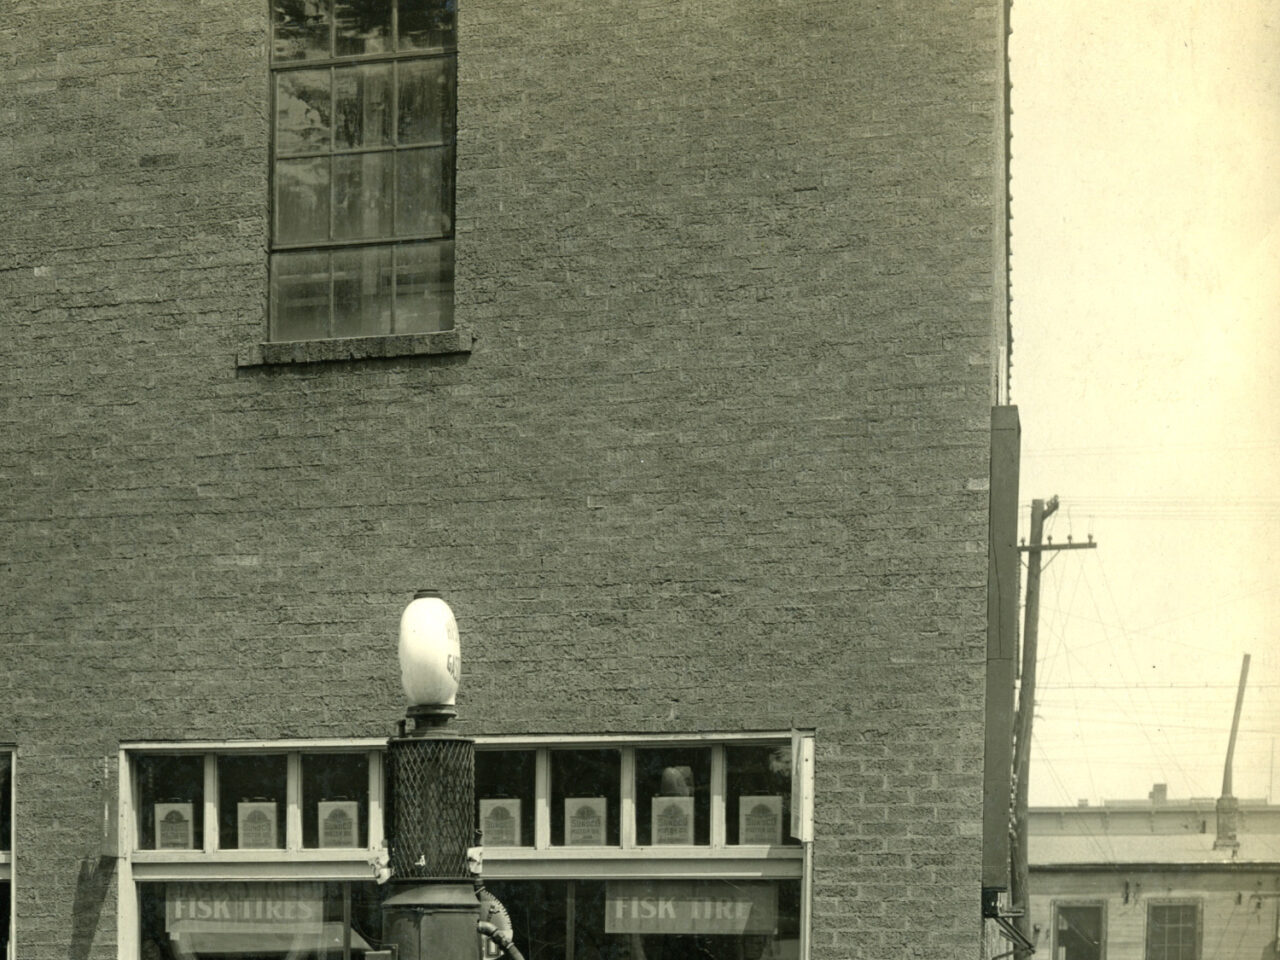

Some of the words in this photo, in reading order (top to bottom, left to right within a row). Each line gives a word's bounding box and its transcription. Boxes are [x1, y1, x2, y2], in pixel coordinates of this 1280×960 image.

[175, 896, 231, 919] FISK
[239, 897, 313, 920] TIRES
[616, 896, 677, 919] FISK
